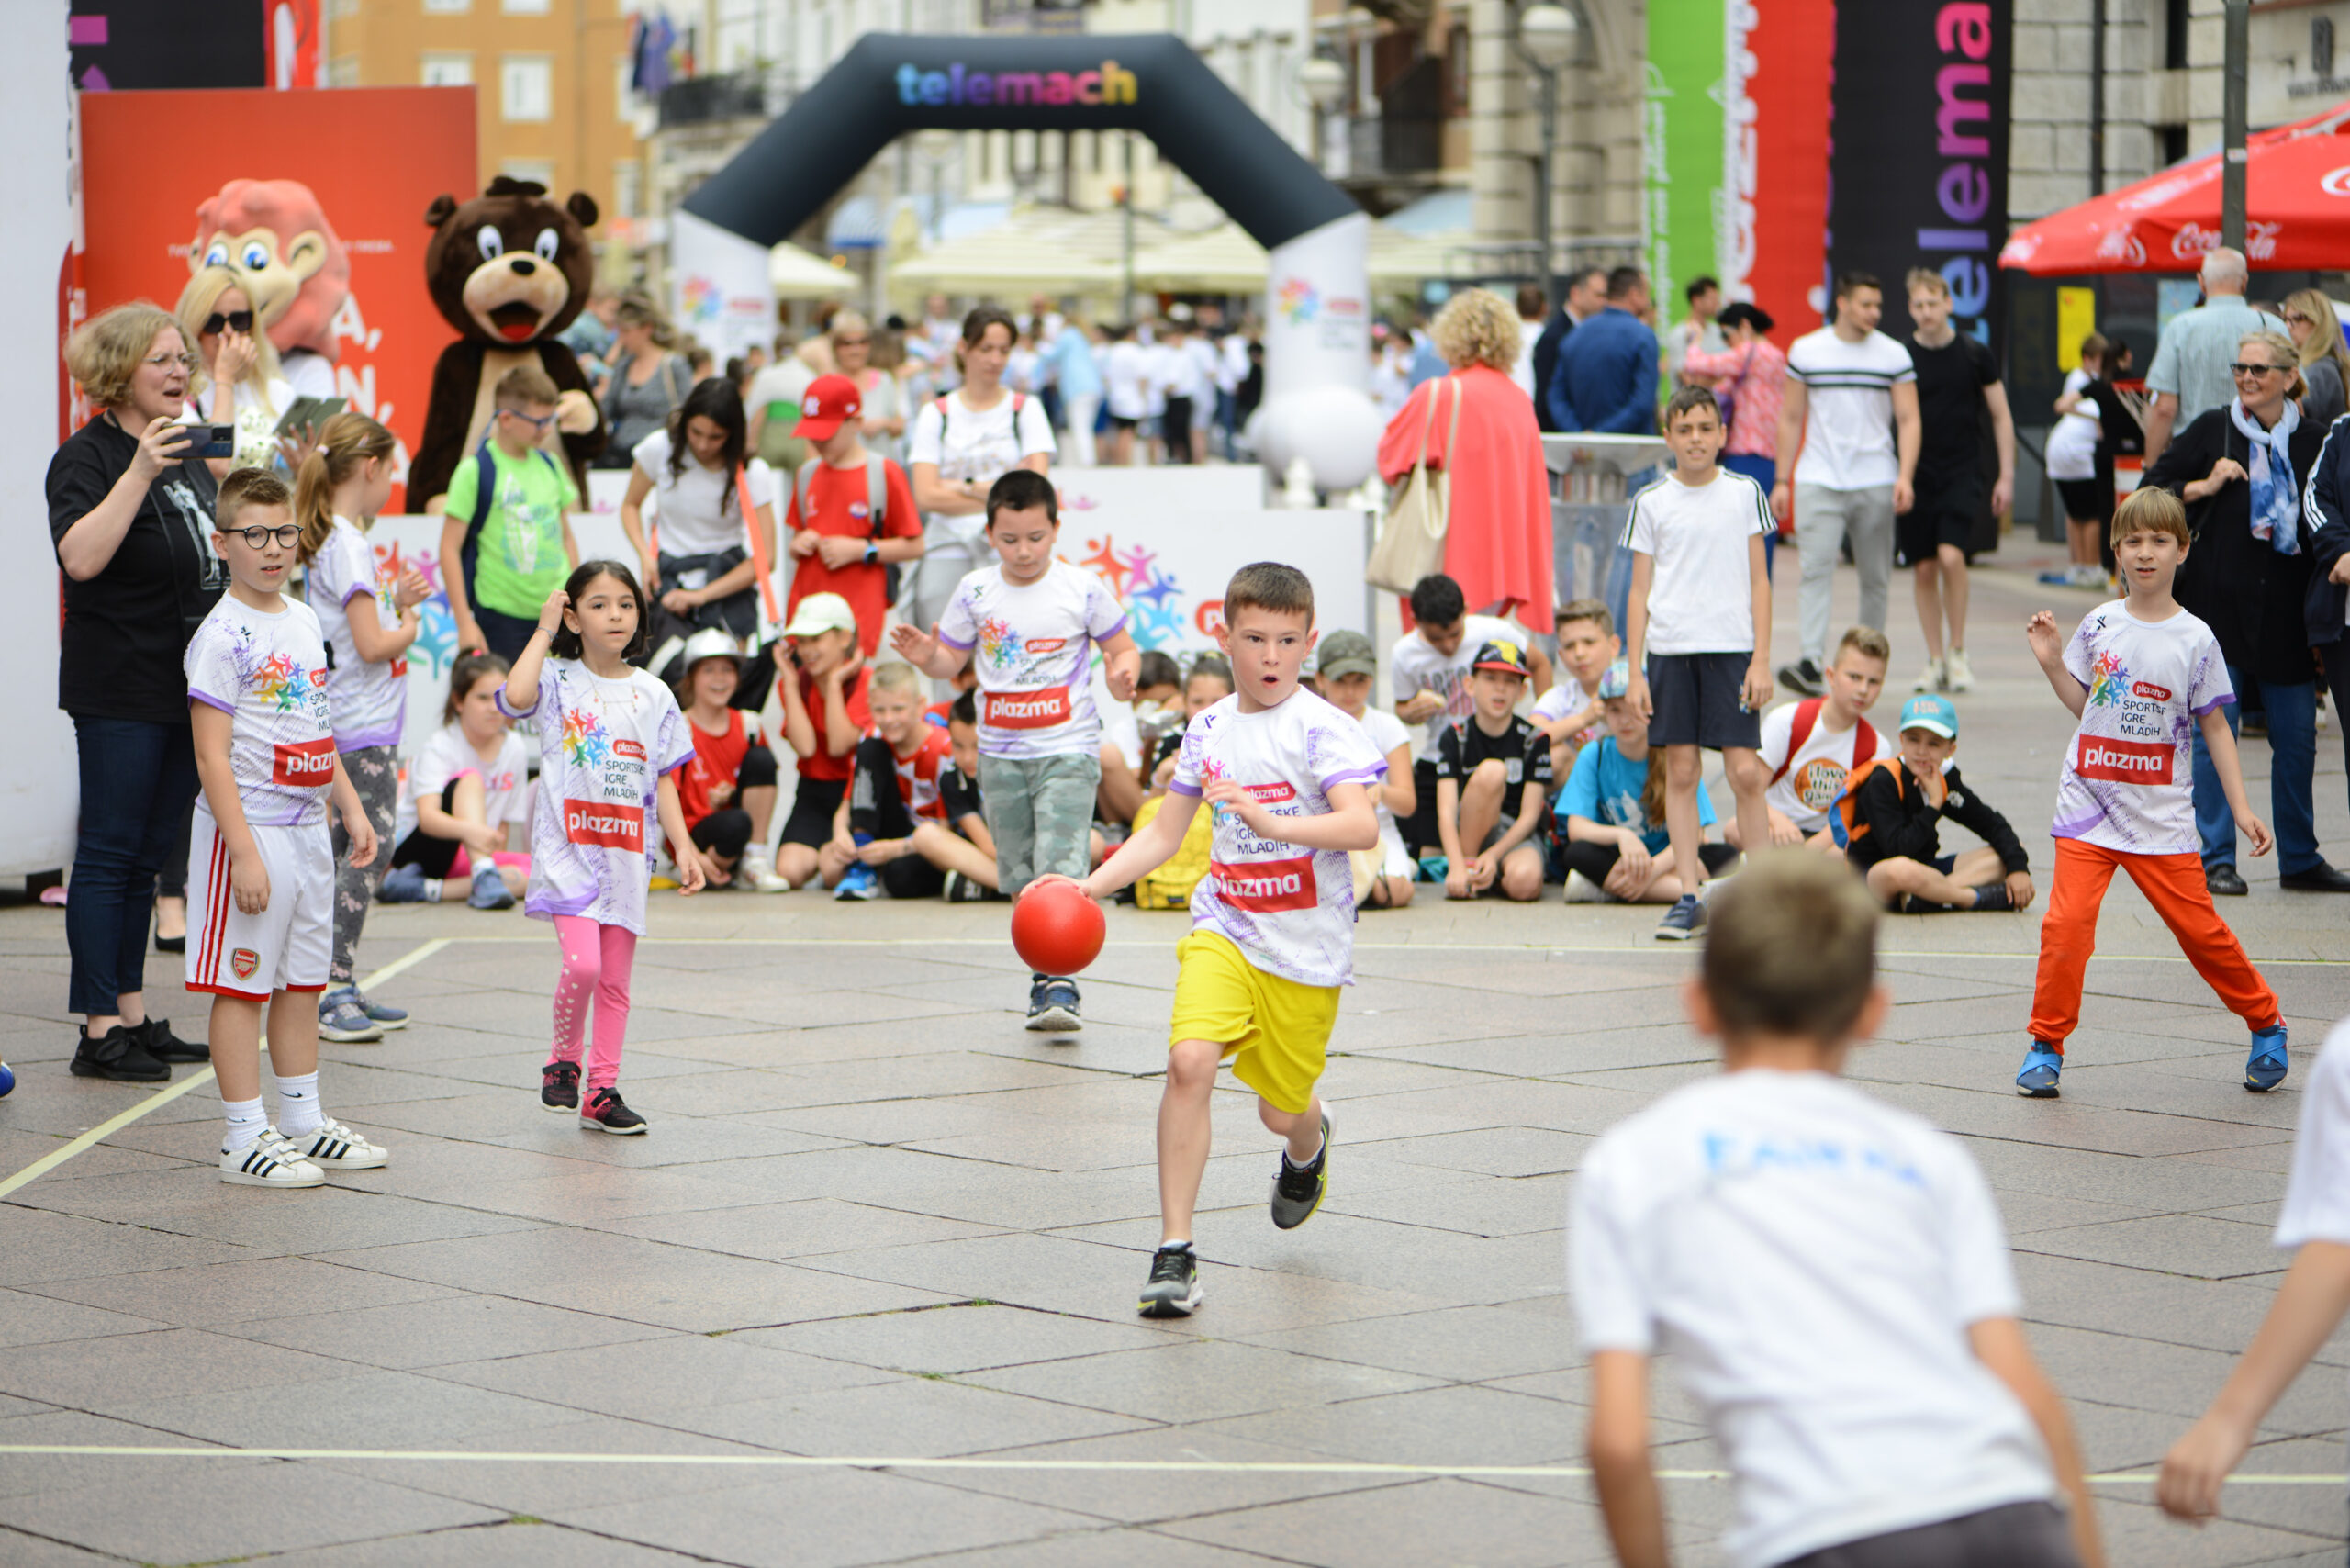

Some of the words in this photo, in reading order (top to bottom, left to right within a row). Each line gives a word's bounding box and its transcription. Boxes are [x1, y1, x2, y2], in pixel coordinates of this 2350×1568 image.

[895, 59, 1138, 106] telemach
[990, 697, 1061, 720] plazma
[2121, 712, 2146, 724] IGRE
[2120, 724, 2161, 736] MLADIH
[2084, 745, 2163, 772] plazma
[604, 773, 627, 785] IGRE
[603, 786, 639, 800] MLADIH
[1236, 827, 1256, 840] IGR
[1237, 839, 1290, 855] MLADIH
